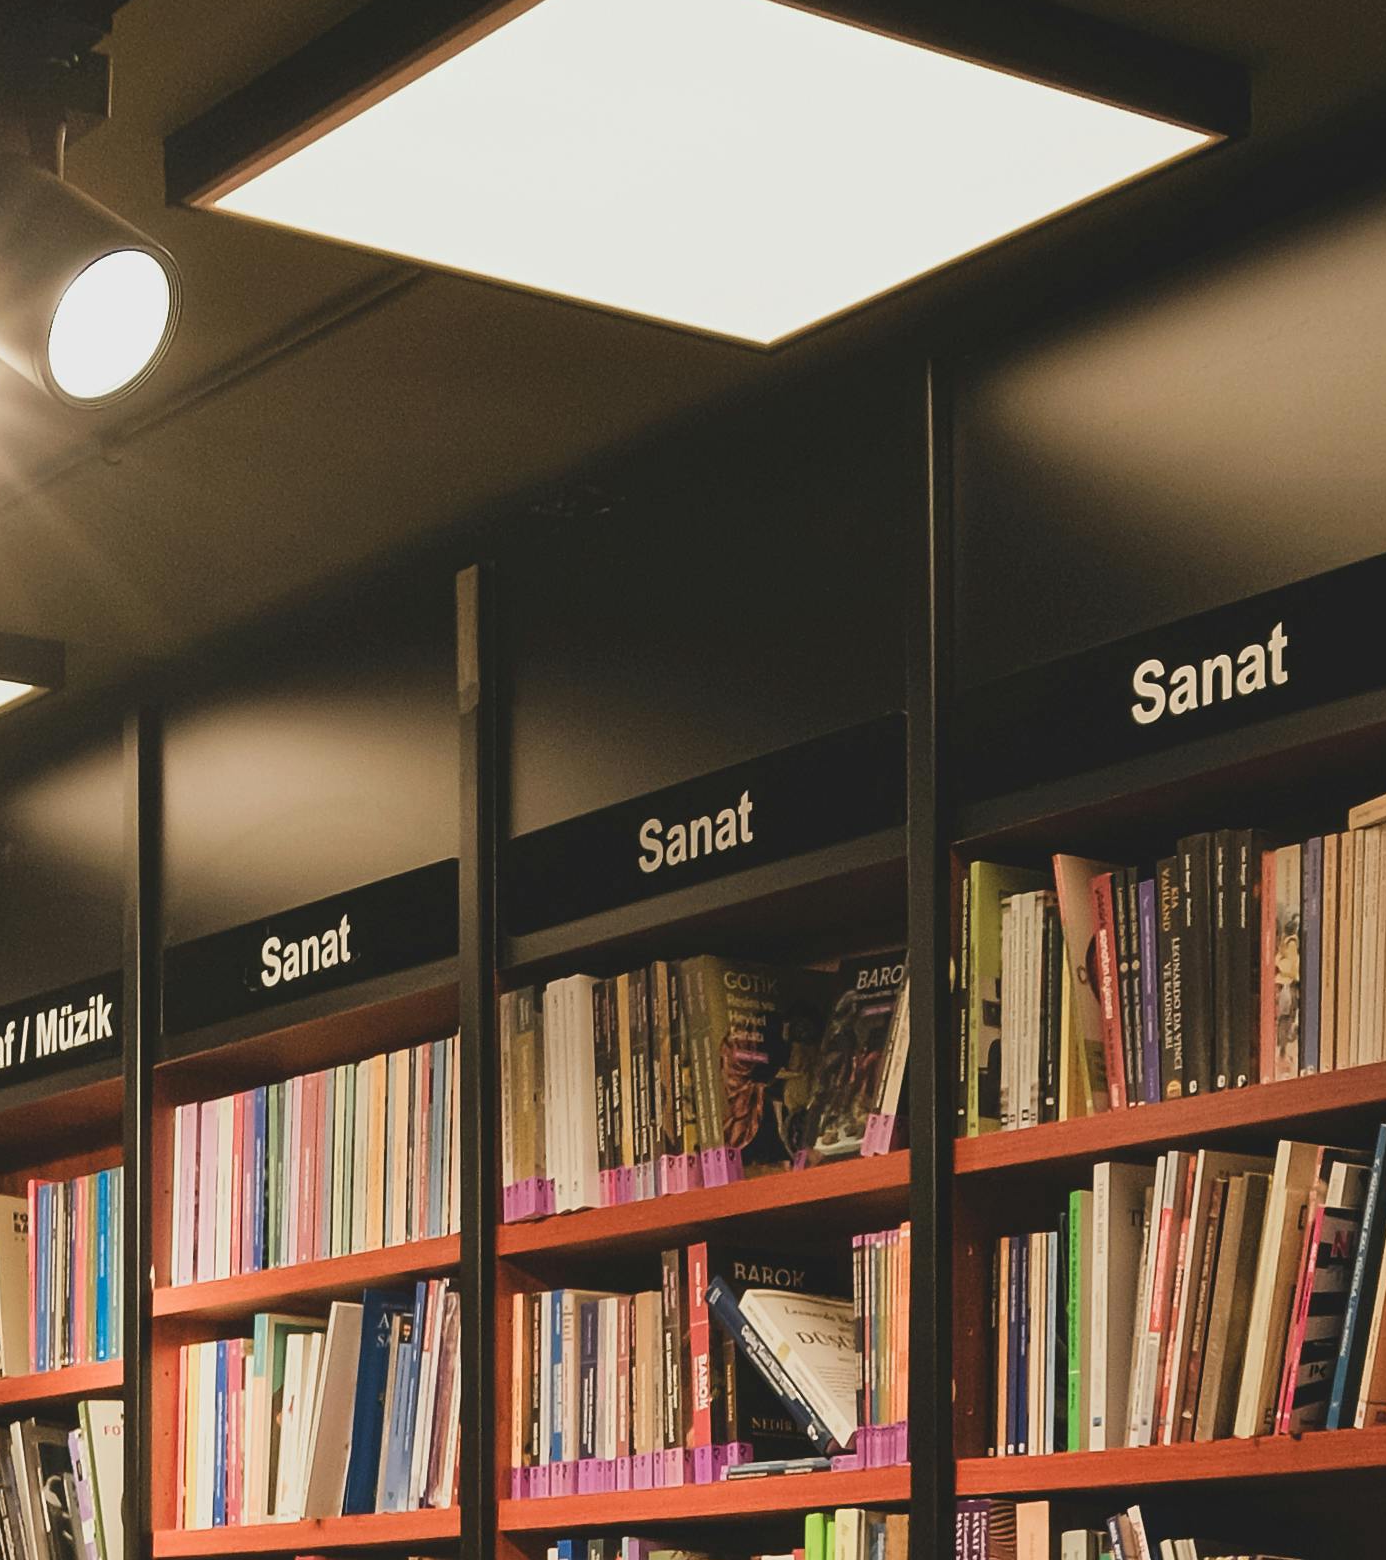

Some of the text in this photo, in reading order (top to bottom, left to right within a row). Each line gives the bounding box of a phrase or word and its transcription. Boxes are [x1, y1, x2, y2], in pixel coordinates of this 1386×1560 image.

[1130, 620, 1290, 726] Sanat
[637, 789, 755, 874] Sanat
[260, 913, 352, 988] Sanat
[856, 964, 908, 990] BARO
[1171, 937, 1181, 1009] LEONARDO
[36, 993, 114, 1052] Müzik
[1173, 1012, 1181, 1032] DA
